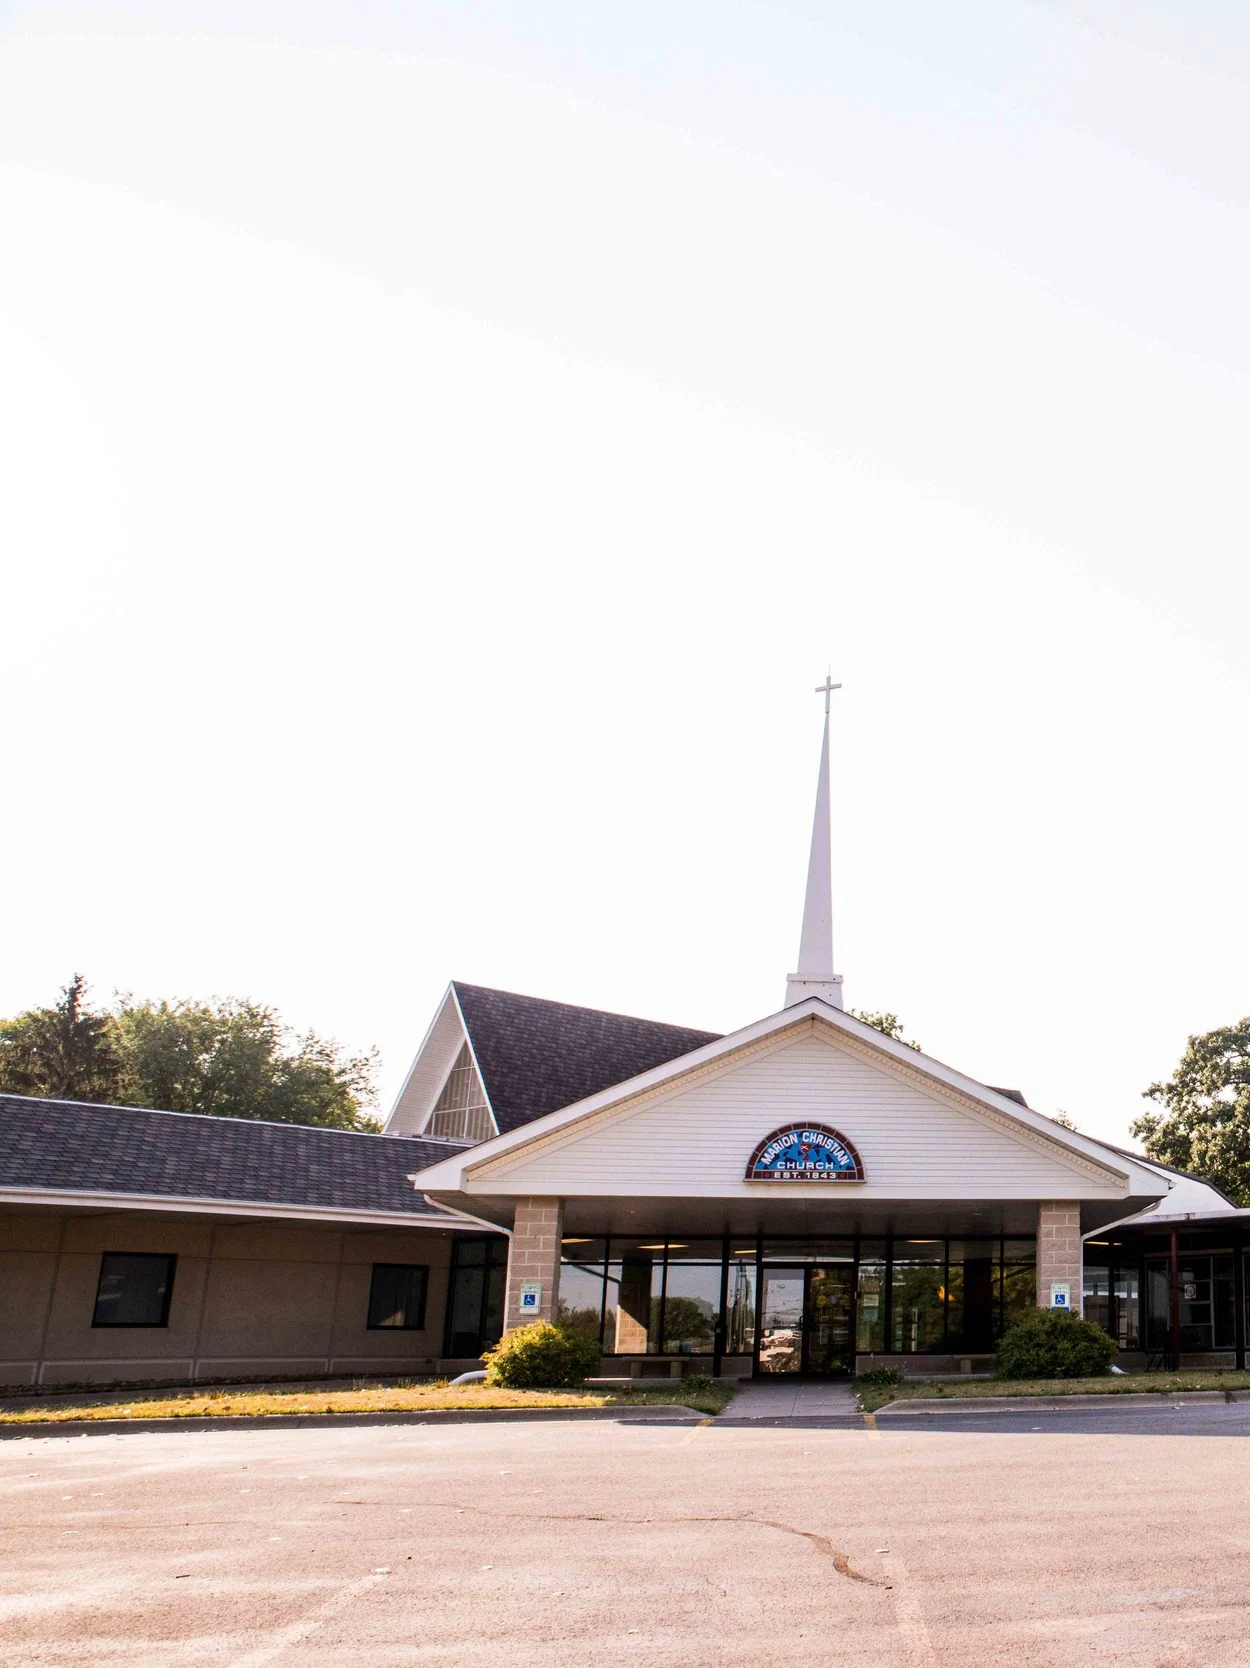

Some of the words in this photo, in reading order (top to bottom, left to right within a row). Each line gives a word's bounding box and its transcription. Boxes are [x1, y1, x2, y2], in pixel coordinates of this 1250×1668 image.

[760, 1133, 799, 1165] MARION
[802, 1132, 850, 1166] CHRISTIAN
[776, 1161, 834, 1170] CHURCH
[774, 1171, 801, 1179] EST.
[805, 1171, 837, 1179] 1843
